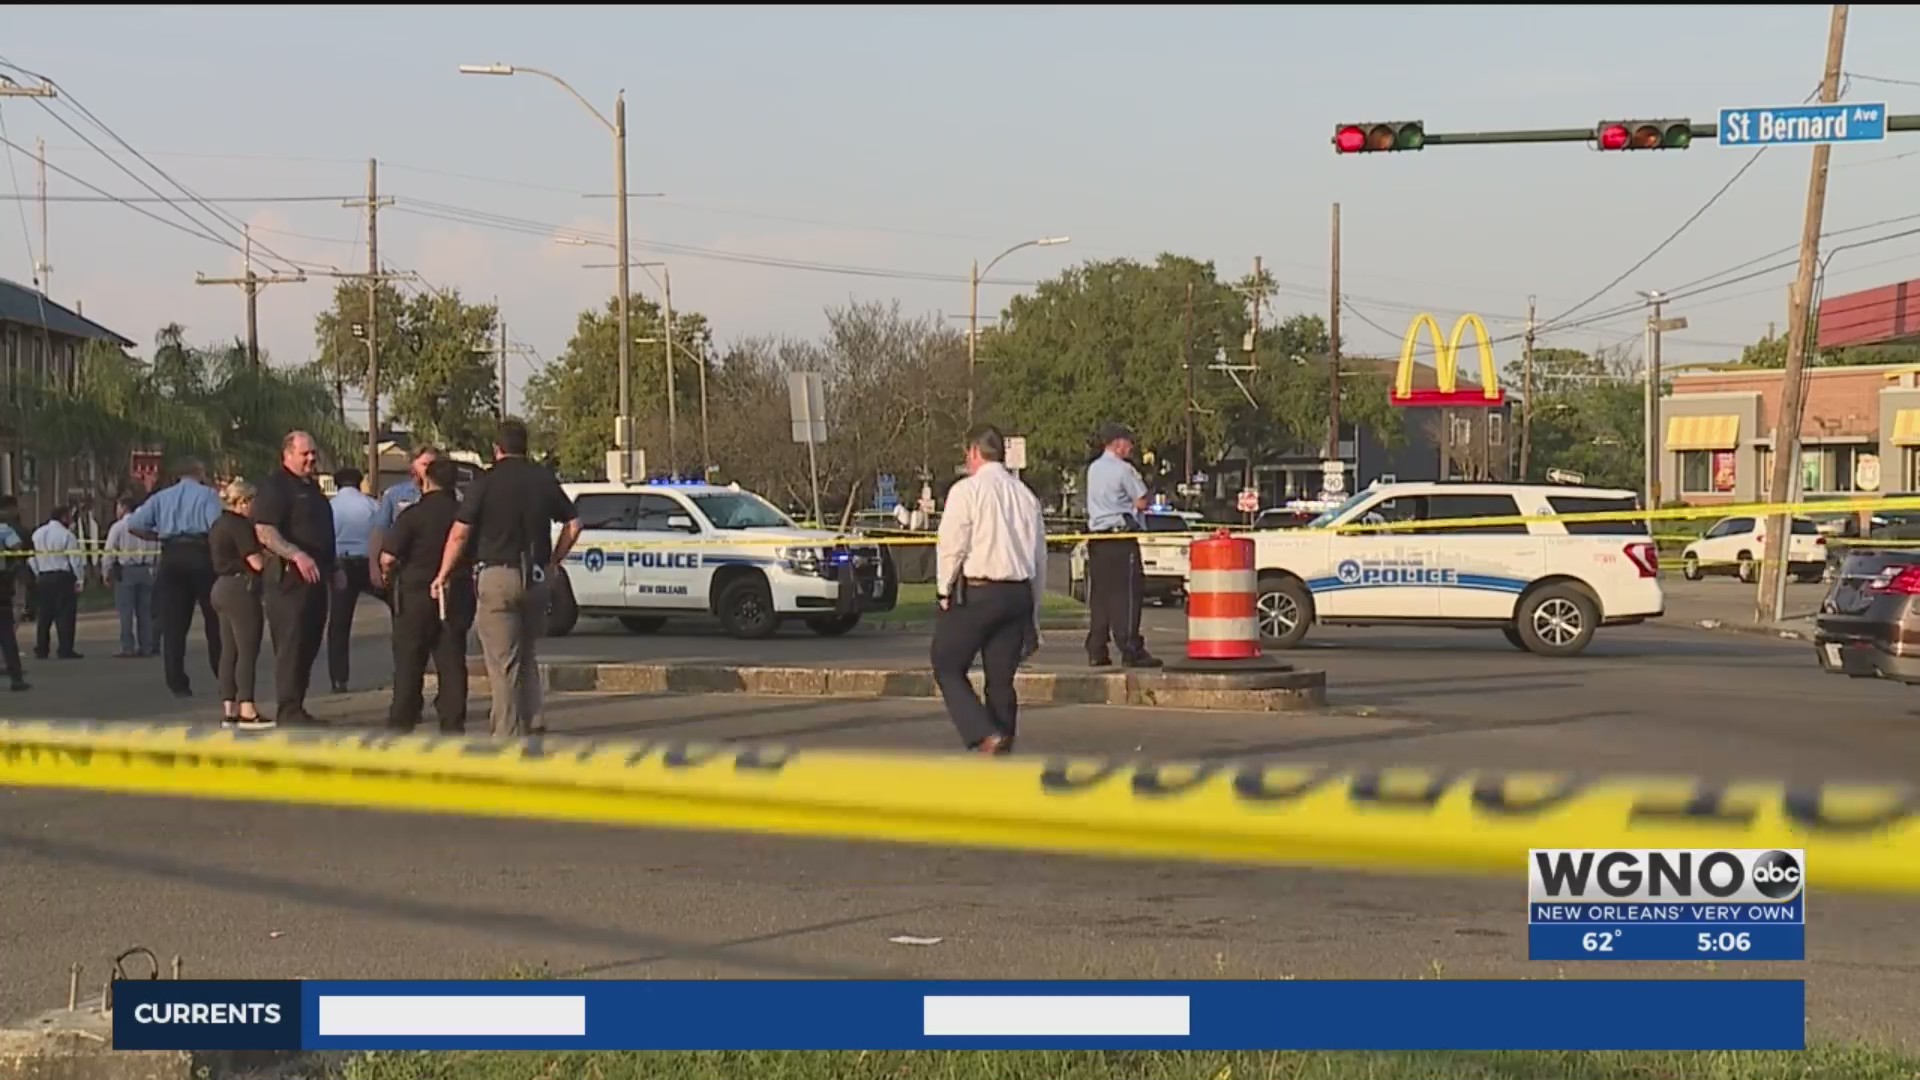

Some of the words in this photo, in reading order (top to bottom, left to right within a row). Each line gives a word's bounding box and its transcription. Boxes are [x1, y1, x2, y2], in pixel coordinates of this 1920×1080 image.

[1727, 112, 1751, 142] St
[1759, 108, 1848, 140] Bernard
[1853, 106, 1879, 122] Ave
[627, 551, 699, 568] POLICE
[1362, 568, 1456, 583] POLICE
